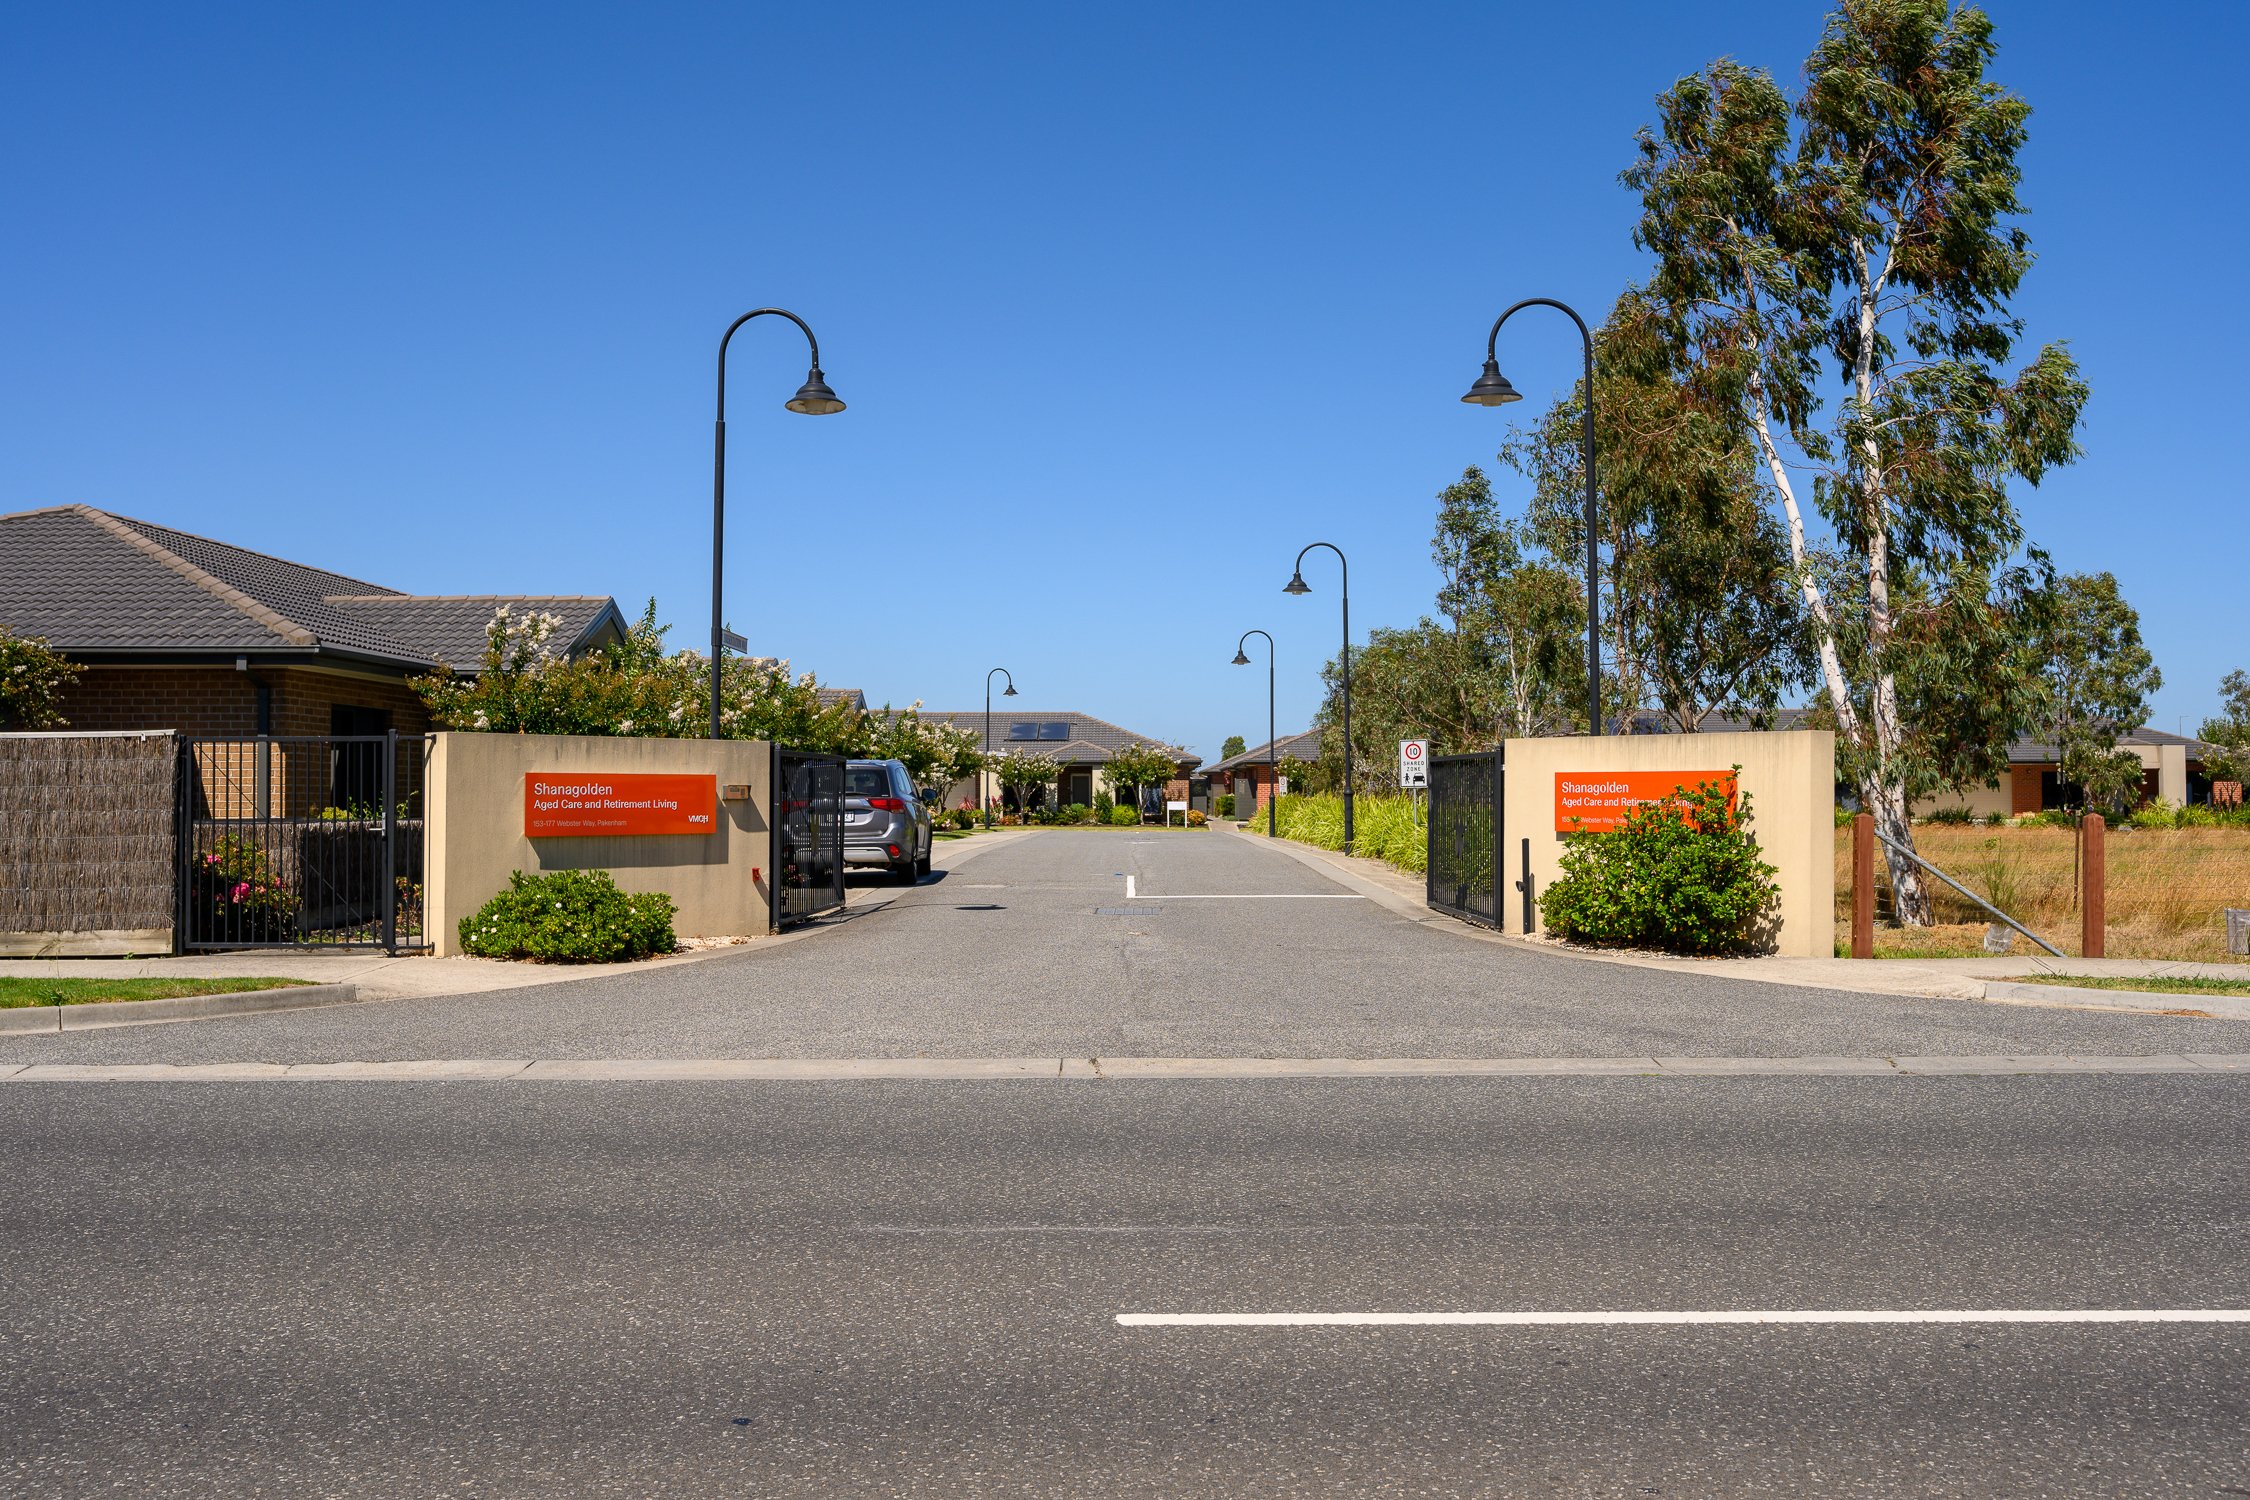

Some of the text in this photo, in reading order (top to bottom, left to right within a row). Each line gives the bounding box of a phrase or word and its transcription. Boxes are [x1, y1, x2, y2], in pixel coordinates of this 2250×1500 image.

[1409, 747, 1418, 755] 10
[534, 782, 613, 797] Shanagolden
[1561, 781, 1629, 795] Shanagolden
[533, 799, 678, 811] Aged Care and Retirement Living
[1561, 797, 1582, 808] Aged
[1583, 797, 1602, 807] Care
[1603, 797, 1619, 807] and
[1621, 797, 1665, 807] Retiremen
[533, 819, 556, 828] 153-177
[556, 819, 581, 827] Webster
[597, 819, 628, 827] Pakenham
